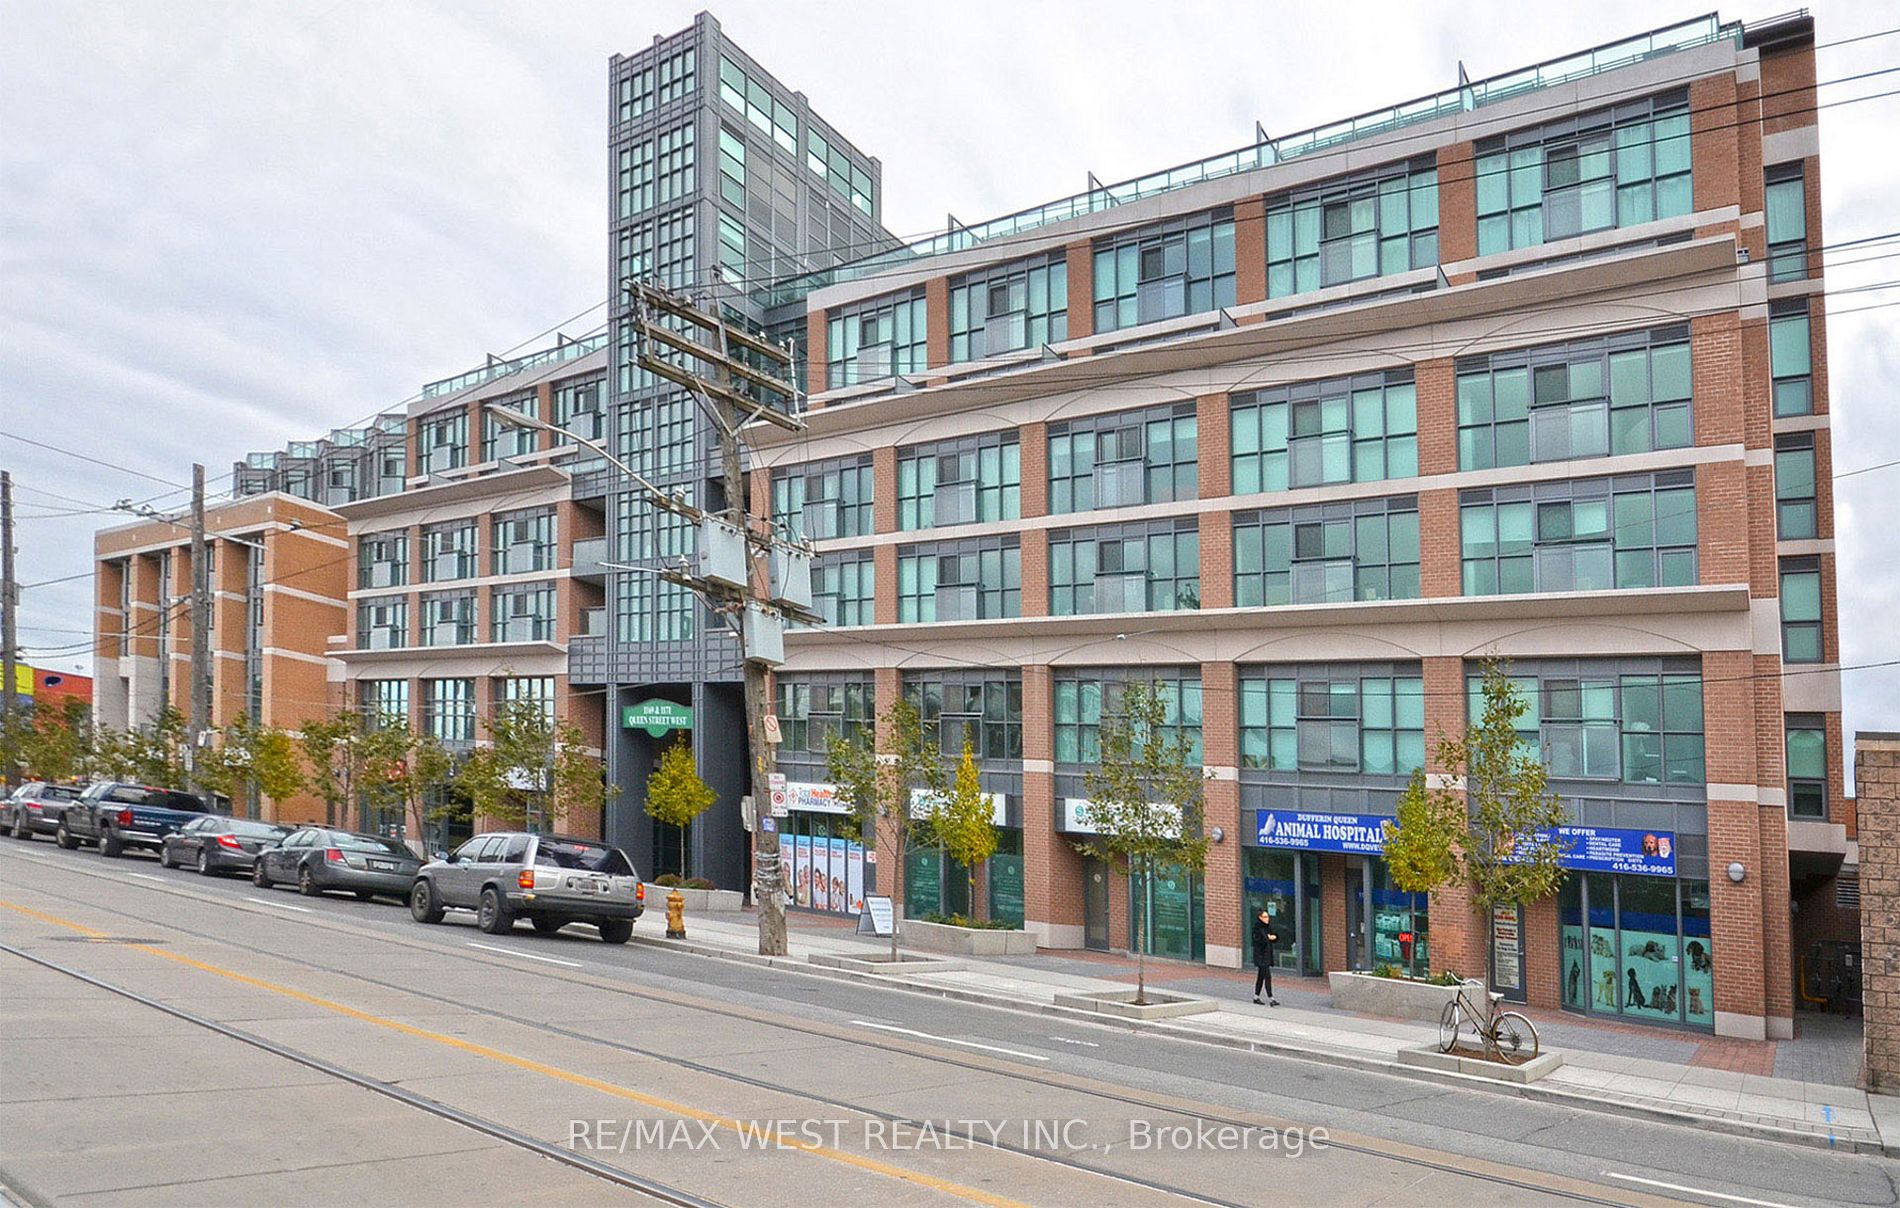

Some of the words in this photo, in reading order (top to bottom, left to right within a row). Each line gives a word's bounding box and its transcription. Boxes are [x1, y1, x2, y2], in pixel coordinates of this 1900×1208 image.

[628, 715, 648, 727] QUEEN
[648, 716, 669, 726] STREET
[670, 716, 688, 726] WEST
[798, 797, 831, 807] PHARMACY
[1297, 813, 1332, 823] DUFFERIN
[1333, 815, 1358, 825] QUEEN
[1275, 821, 1322, 839] ANIMAL
[1322, 824, 1383, 843] HOSPITAL
[1558, 827, 1571, 836] WE
[1572, 828, 1597, 837] OFFER
[1259, 835, 1309, 847] 416-536-9965
[1612, 863, 1674, 875] 416-536-9965
